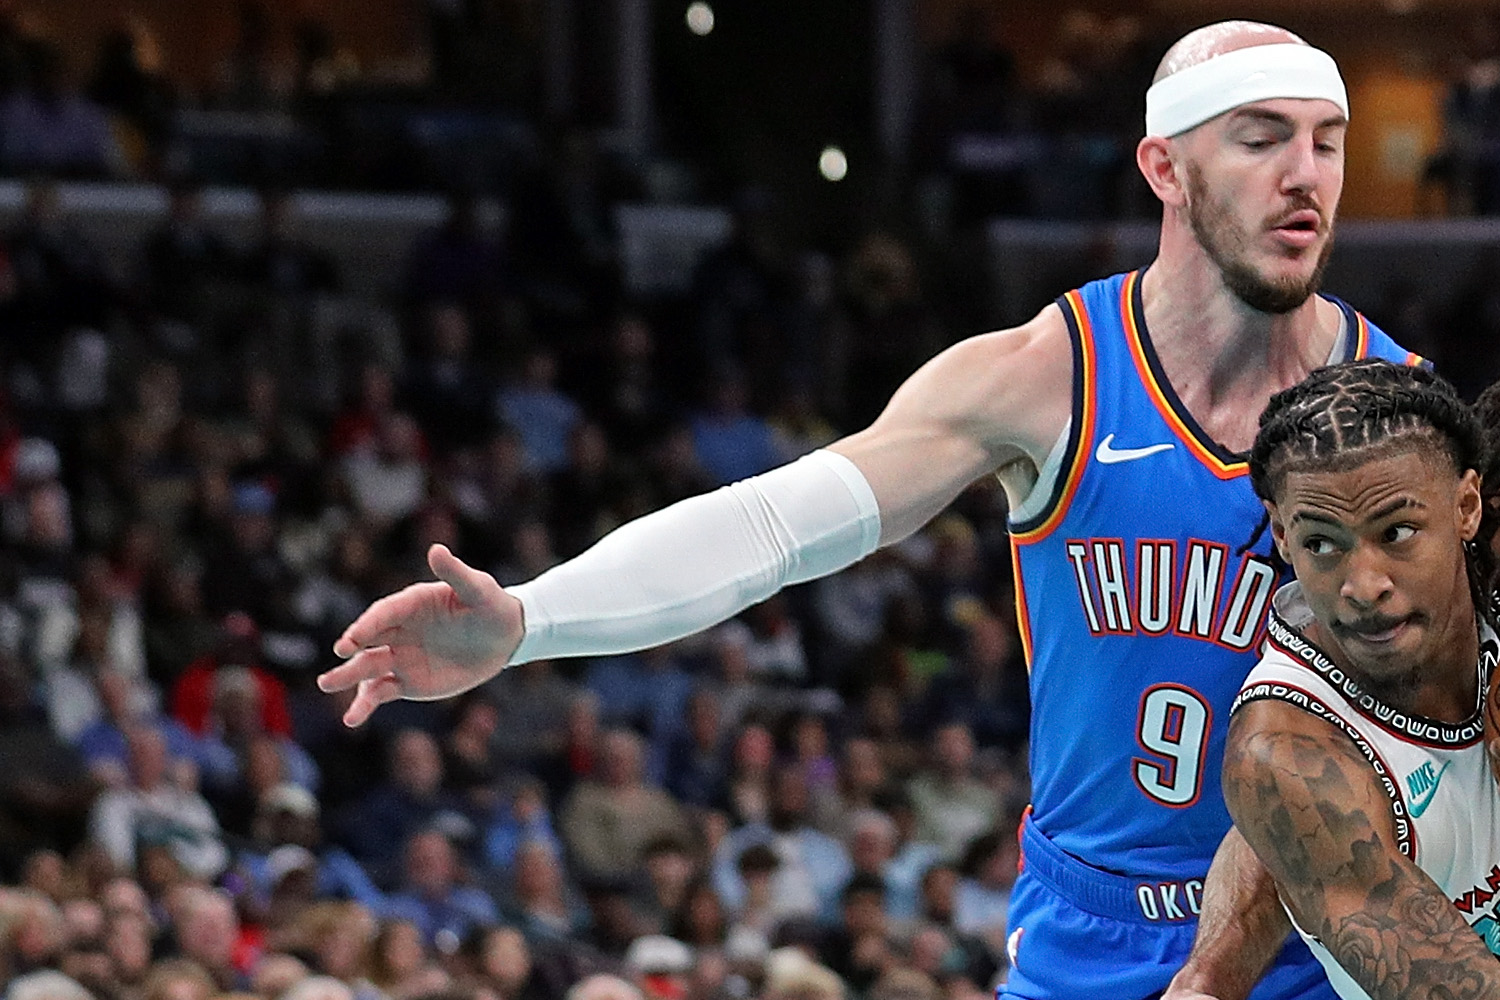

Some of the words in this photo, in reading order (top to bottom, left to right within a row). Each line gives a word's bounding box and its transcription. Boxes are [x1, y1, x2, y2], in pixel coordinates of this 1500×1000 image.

[1067, 538, 1281, 659] THUND
[1133, 683, 1213, 808] 9
[1405, 760, 1437, 800] NIKE
[1137, 881, 1204, 920] OKC
